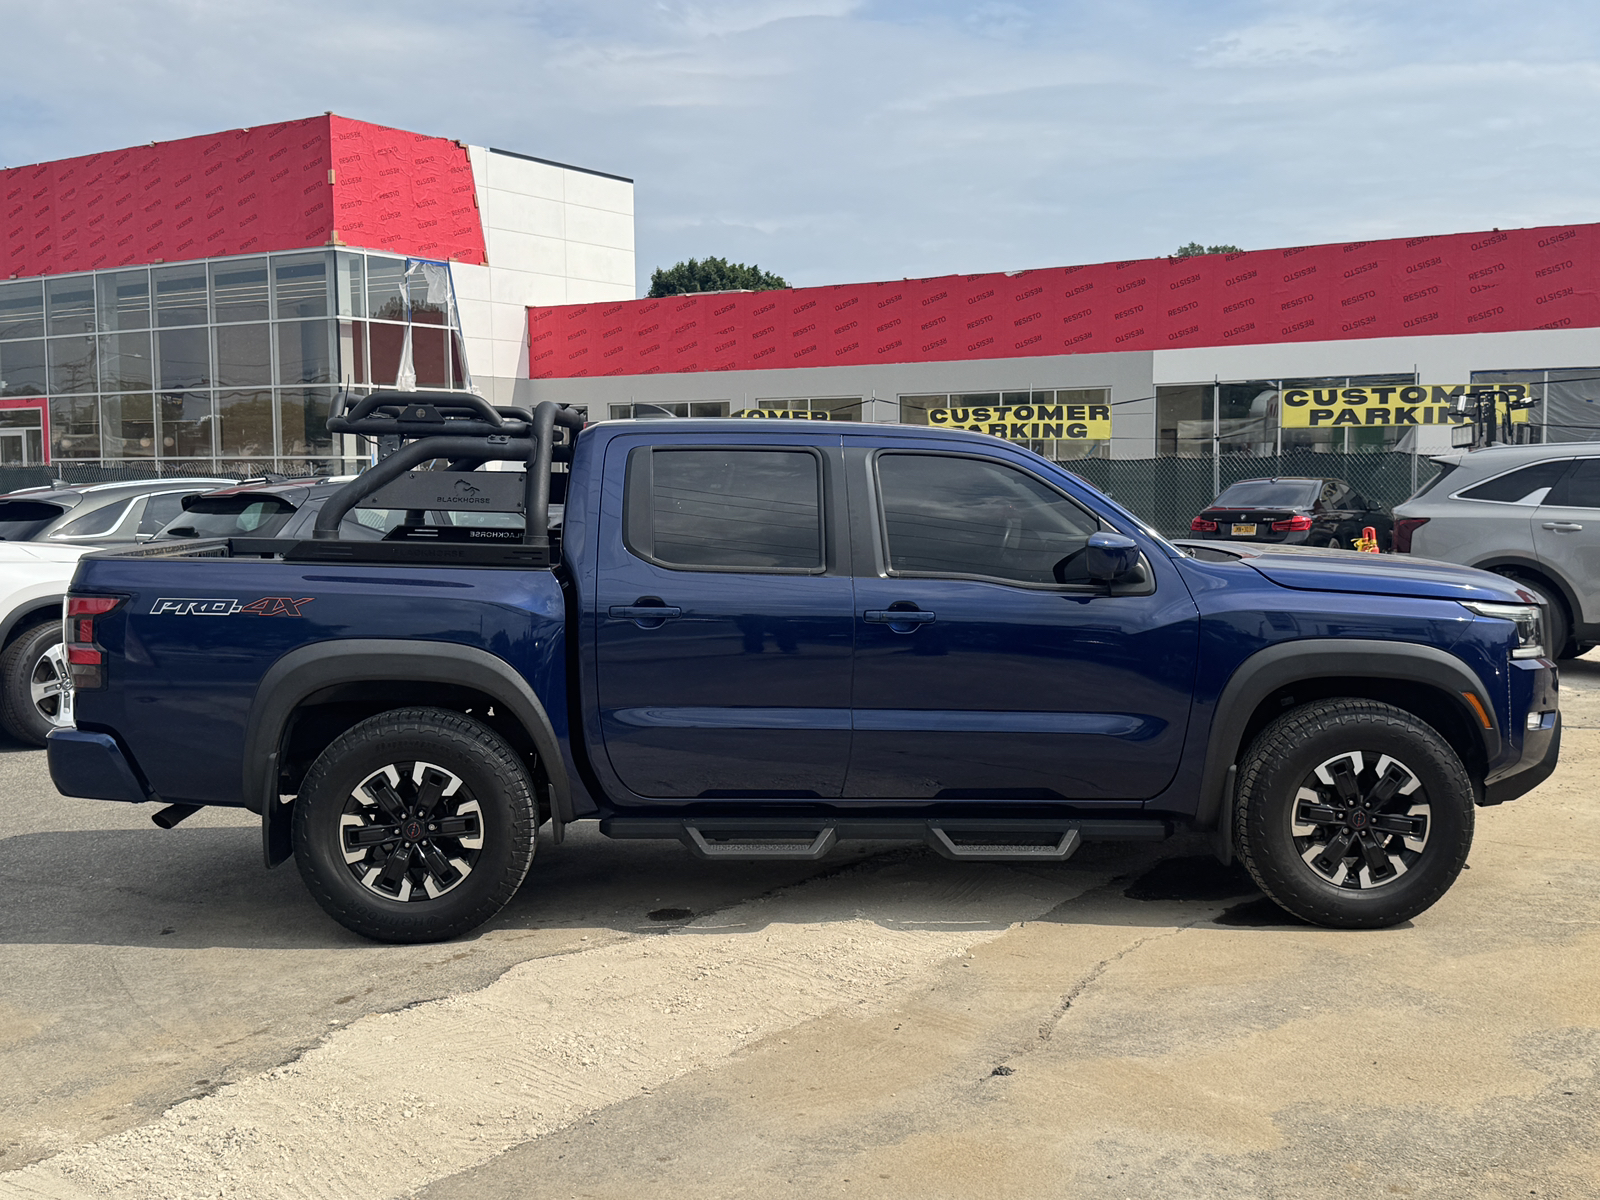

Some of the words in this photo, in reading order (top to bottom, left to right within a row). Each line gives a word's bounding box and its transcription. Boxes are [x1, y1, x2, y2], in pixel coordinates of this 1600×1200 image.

[1471, 233, 1507, 251] RESISTO
[1538, 230, 1576, 248] RESISTO
[1344, 261, 1378, 278] RESISTO
[1406, 257, 1441, 274] RESISTO
[1468, 263, 1506, 280] RESISTO
[1535, 260, 1572, 278] RESISTO
[1226, 270, 1257, 286] RESISTO
[1284, 266, 1316, 282] RESISTO
[1117, 278, 1146, 293] RESISTO
[1170, 274, 1200, 290] RESISTO
[968, 290, 994, 304] RESISTO
[1016, 286, 1043, 301] RESISTO
[1066, 283, 1093, 298] RESISTO
[1403, 286, 1438, 303] RESISTO
[1536, 287, 1574, 304] RESISTO
[835, 297, 858, 311] RESISTO
[878, 294, 902, 308] RESISTO
[922, 291, 947, 306] RESISTO
[1223, 298, 1255, 314] RESISTO
[1281, 294, 1314, 310] RESISTO
[1341, 290, 1376, 307] RESISTO
[753, 303, 775, 316] RESISTO
[794, 300, 816, 314] RESISTO
[1115, 305, 1143, 320] RESISTO
[1168, 301, 1198, 317] RESISTO
[1468, 306, 1504, 323] RESISTO
[921, 316, 946, 330] RESISTO
[967, 315, 993, 330] RESISTO
[1014, 312, 1041, 327] RESISTO
[1063, 309, 1092, 324] RESISTO
[1342, 316, 1376, 332] RESISTO
[1403, 312, 1438, 328] RESISTO
[752, 326, 774, 339] RESISTO
[793, 324, 815, 337] RESISTO
[834, 321, 858, 334] RESISTO
[877, 319, 901, 332] RESISTO
[1168, 325, 1198, 340] RESISTO
[1224, 323, 1255, 338] RESISTO
[1282, 319, 1314, 335] RESISTO
[1015, 335, 1042, 349] RESISTO
[1064, 332, 1092, 346] RESISTO
[1115, 328, 1144, 343] RESISTO
[794, 345, 816, 358] RESISTO
[836, 342, 859, 356] RESISTO
[878, 340, 902, 354] RESISTO
[922, 338, 947, 352] RESISTO
[968, 337, 994, 351] RESISTO
[753, 347, 775, 360] RESISTO
[930, 405, 1109, 423] CUSTOMER
[437, 496, 491, 504] BLACKHORSE
